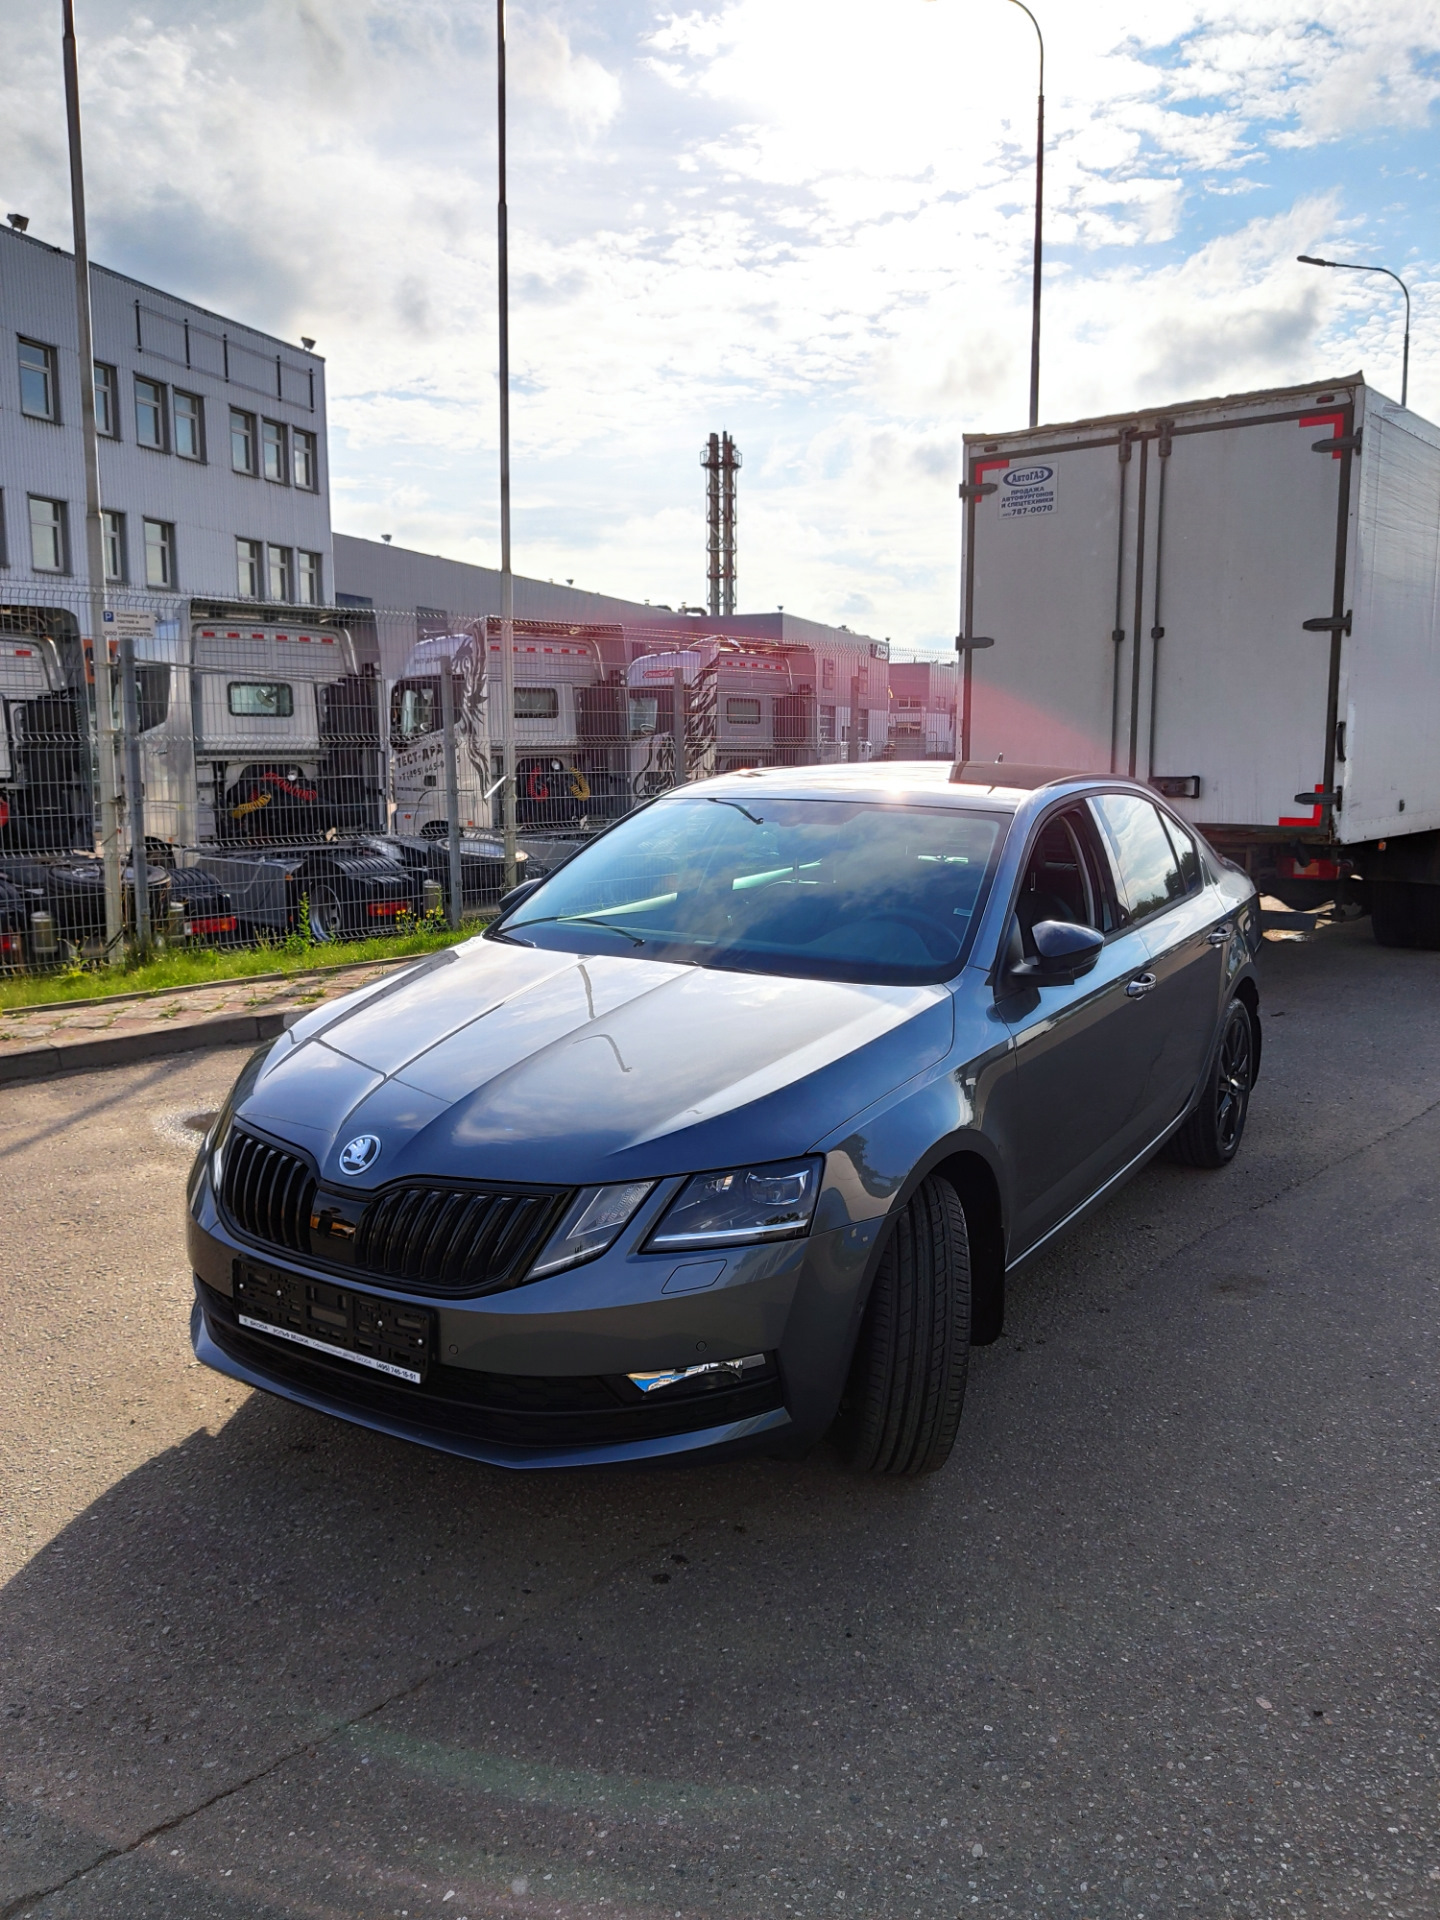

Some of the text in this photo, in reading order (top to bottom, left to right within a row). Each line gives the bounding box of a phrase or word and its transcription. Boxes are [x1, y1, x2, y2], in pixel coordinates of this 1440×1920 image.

[1010, 486, 1044, 495] ПРОДАЖА
[1002, 491, 1054, 503] АВТОФУРГОНОВ
[1007, 497, 1054, 508] СПЕЦТЕХНИКИ
[1011, 504, 1053, 516] 787-0070
